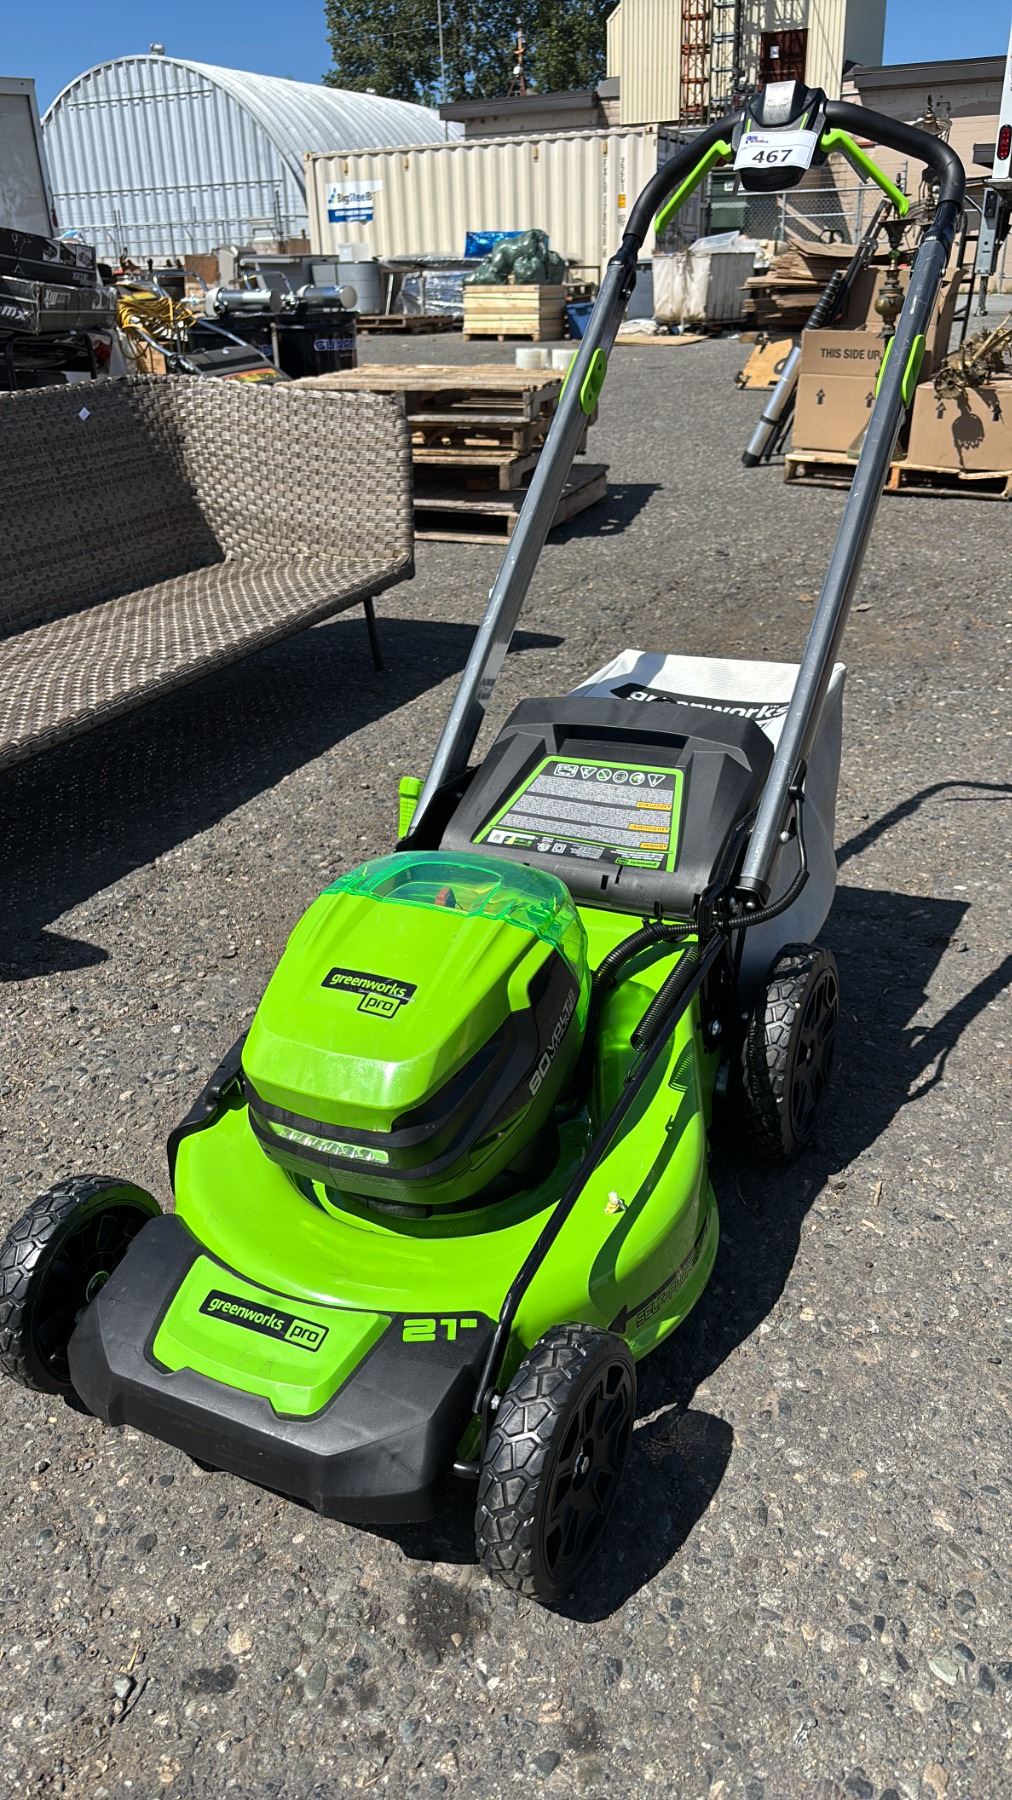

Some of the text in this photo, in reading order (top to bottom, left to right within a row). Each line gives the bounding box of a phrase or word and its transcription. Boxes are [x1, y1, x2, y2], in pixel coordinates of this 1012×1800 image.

[752, 149, 793, 163] 467
[821, 348, 841, 359] THIS
[843, 348, 865, 360] SIDE
[329, 973, 407, 997] greenworks
[365, 997, 394, 1011] pro
[207, 1298, 320, 1343] greenworks pro
